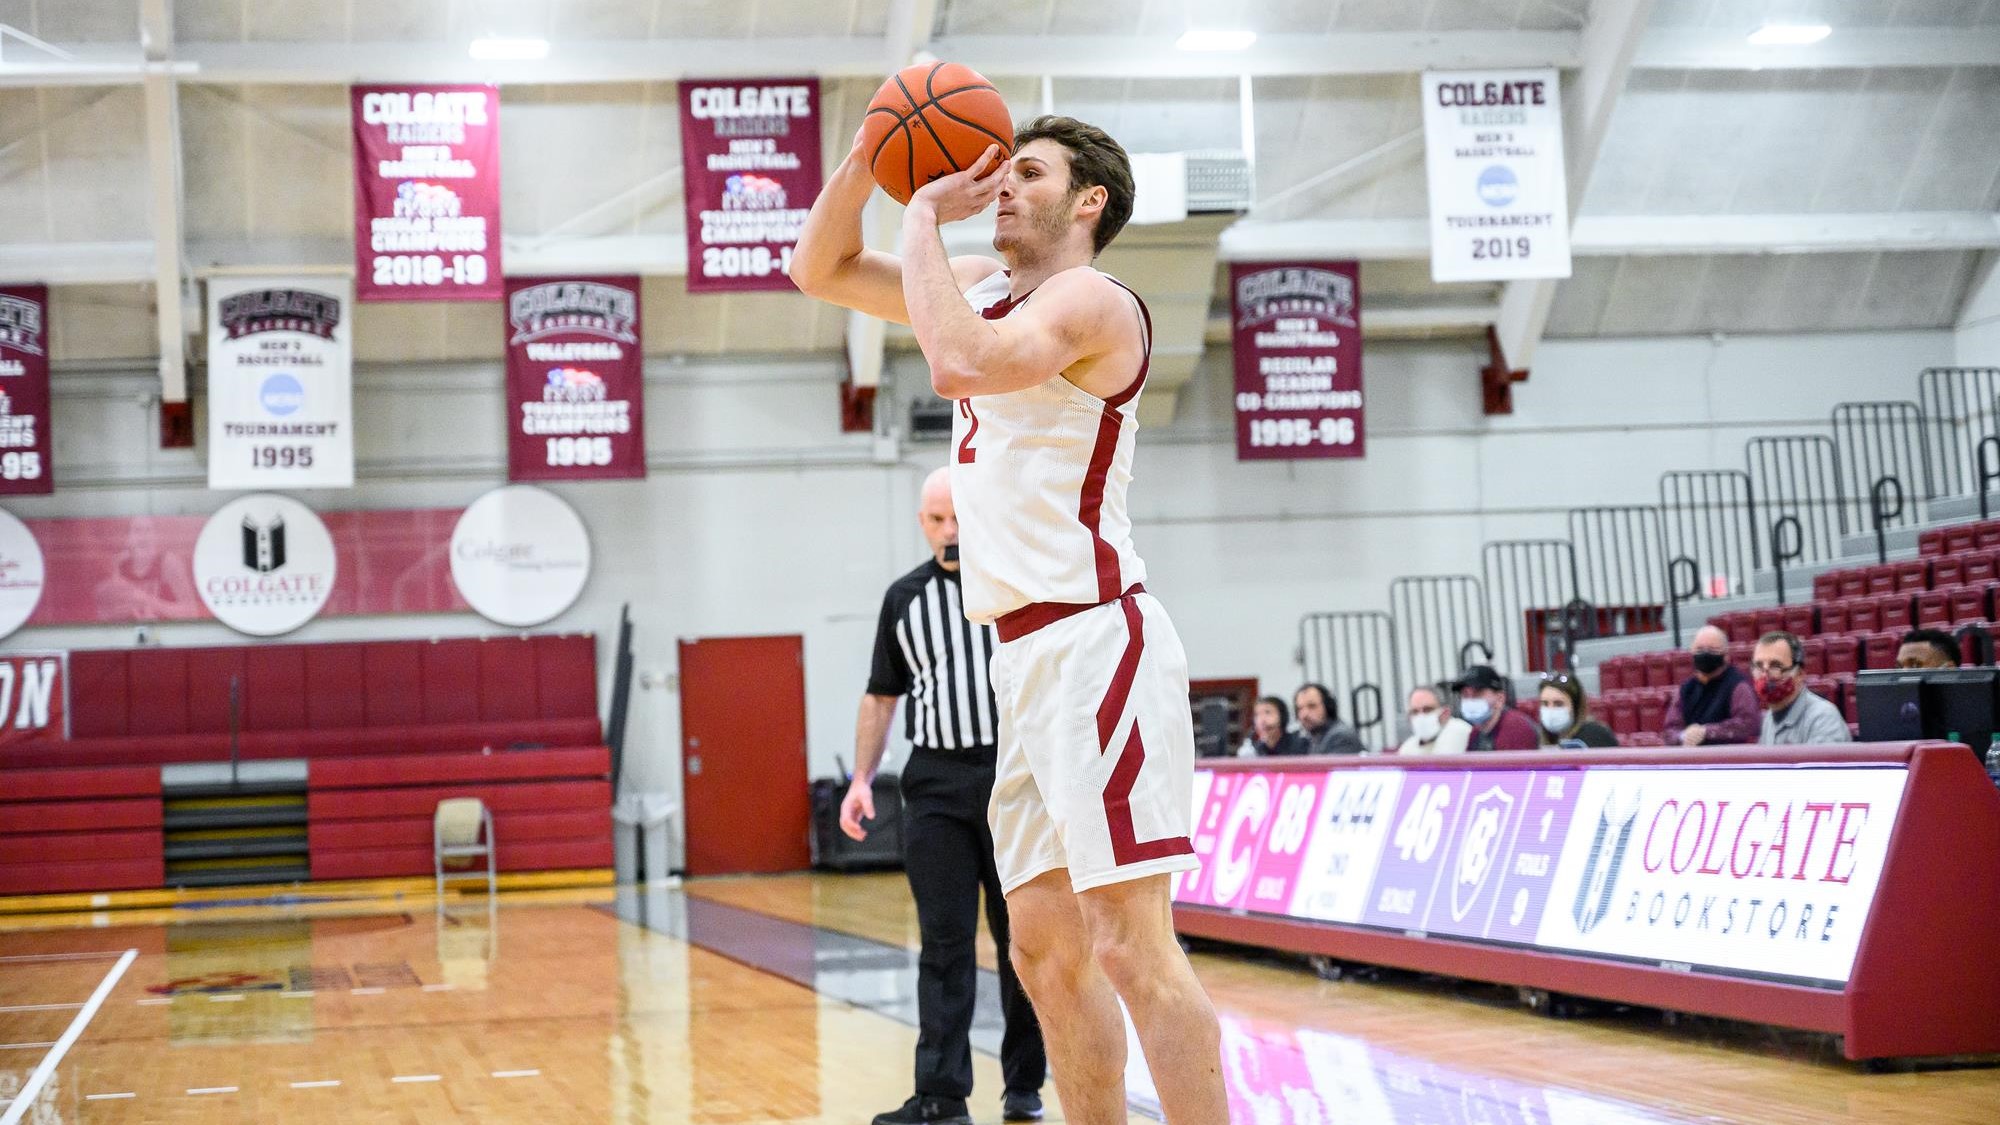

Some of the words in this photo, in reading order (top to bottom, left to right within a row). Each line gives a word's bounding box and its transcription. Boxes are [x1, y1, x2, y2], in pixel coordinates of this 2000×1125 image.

[363, 92, 487, 125] COLGATE
[691, 87, 810, 118] COLGATE
[1438, 81, 1545, 107] COLGATE
[1447, 213, 1553, 228] TOURNAMENT
[703, 246, 791, 276] 2018-1
[1472, 237, 1531, 260] 2019
[373, 255, 487, 285] 2018-19
[224, 423, 338, 437] TOURNAMENT
[1251, 418, 1354, 446] 1995-96
[252, 446, 314, 469] 1995
[546, 437, 612, 466] 1995
[208, 575, 321, 594] COLGATE
[1269, 784, 1316, 854] 88
[1394, 783, 1451, 863] 46
[1643, 798, 1870, 884] COLGATE
[1509, 887, 1530, 926] 9
[1625, 890, 1840, 942] BOOKSTORE
